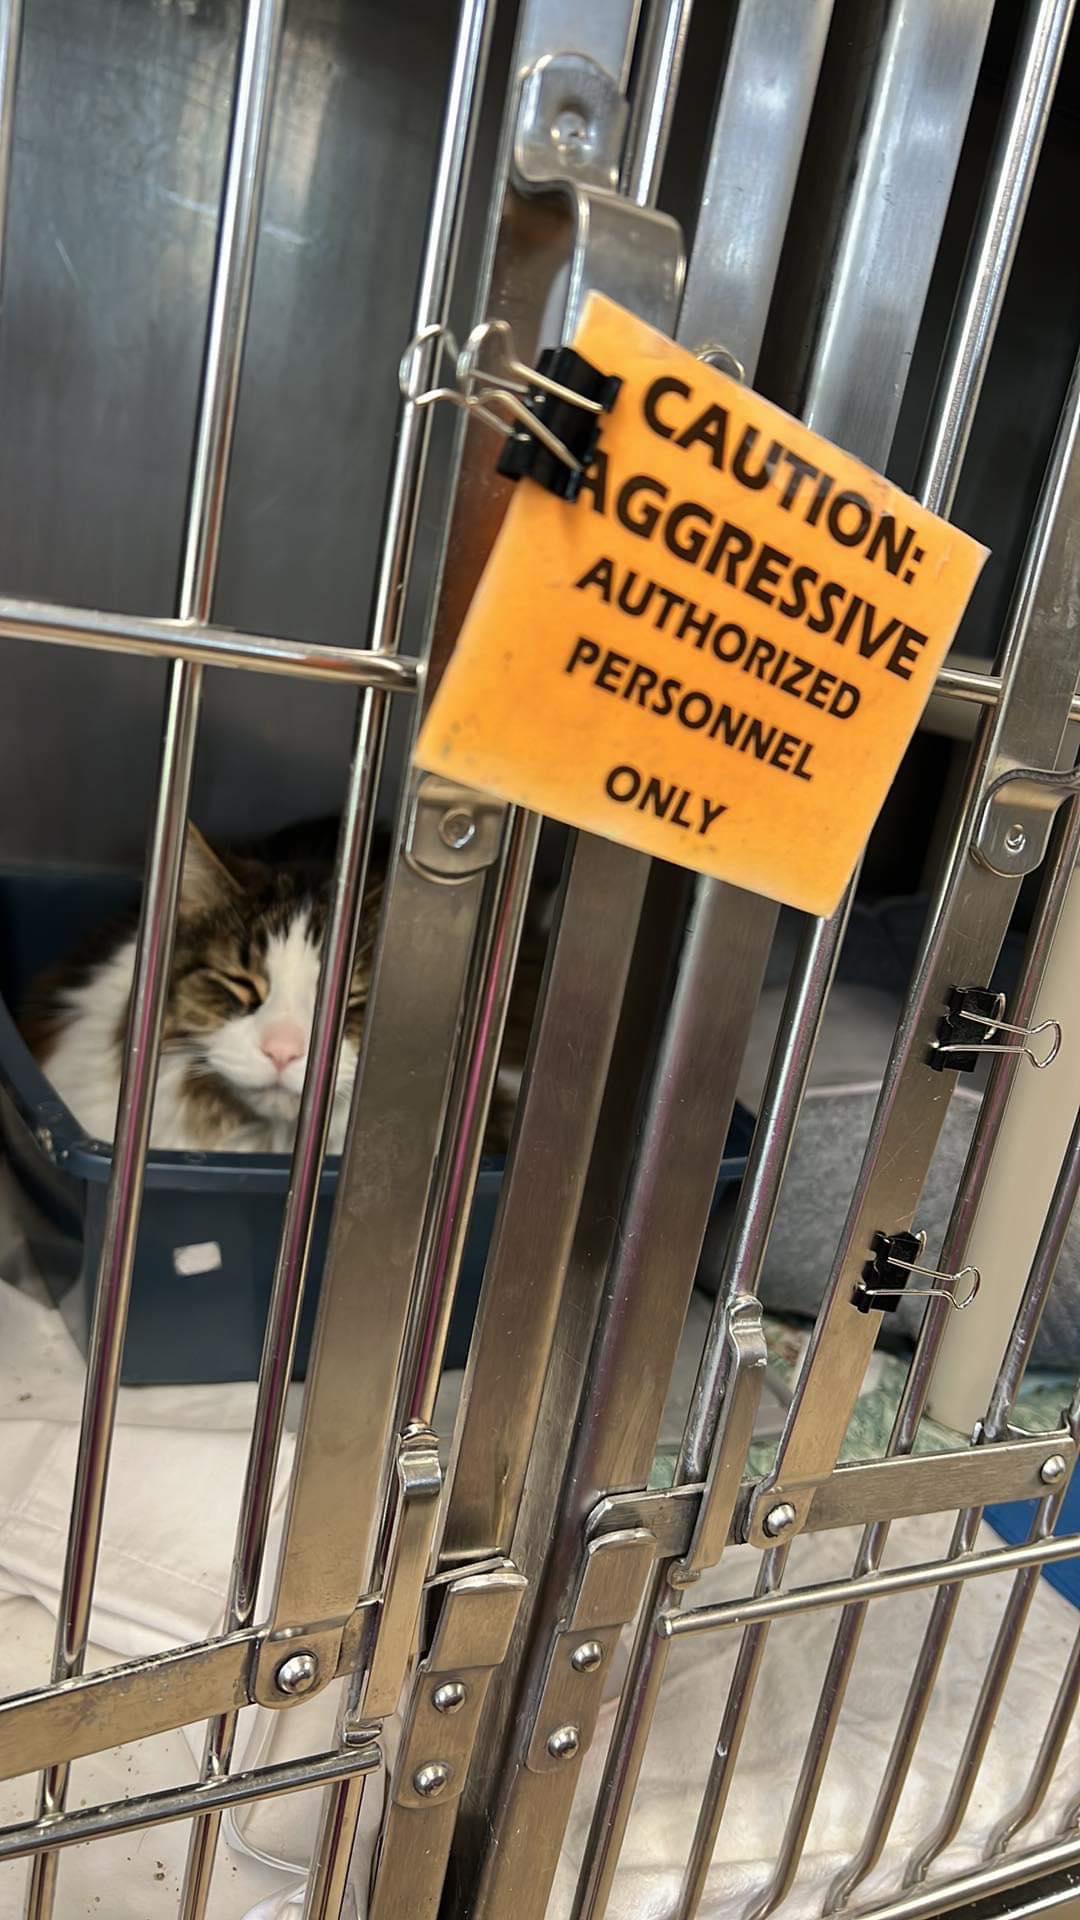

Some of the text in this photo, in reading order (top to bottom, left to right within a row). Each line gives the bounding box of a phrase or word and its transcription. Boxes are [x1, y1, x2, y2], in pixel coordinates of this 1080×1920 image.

[644, 376, 924, 584] CAUTION:
[576, 558, 861, 720] AUTHORIZED
[577, 450, 928, 680] AGGRESSIVE
[565, 637, 815, 781] PERSONNEL
[605, 766, 727, 836] ONLY
